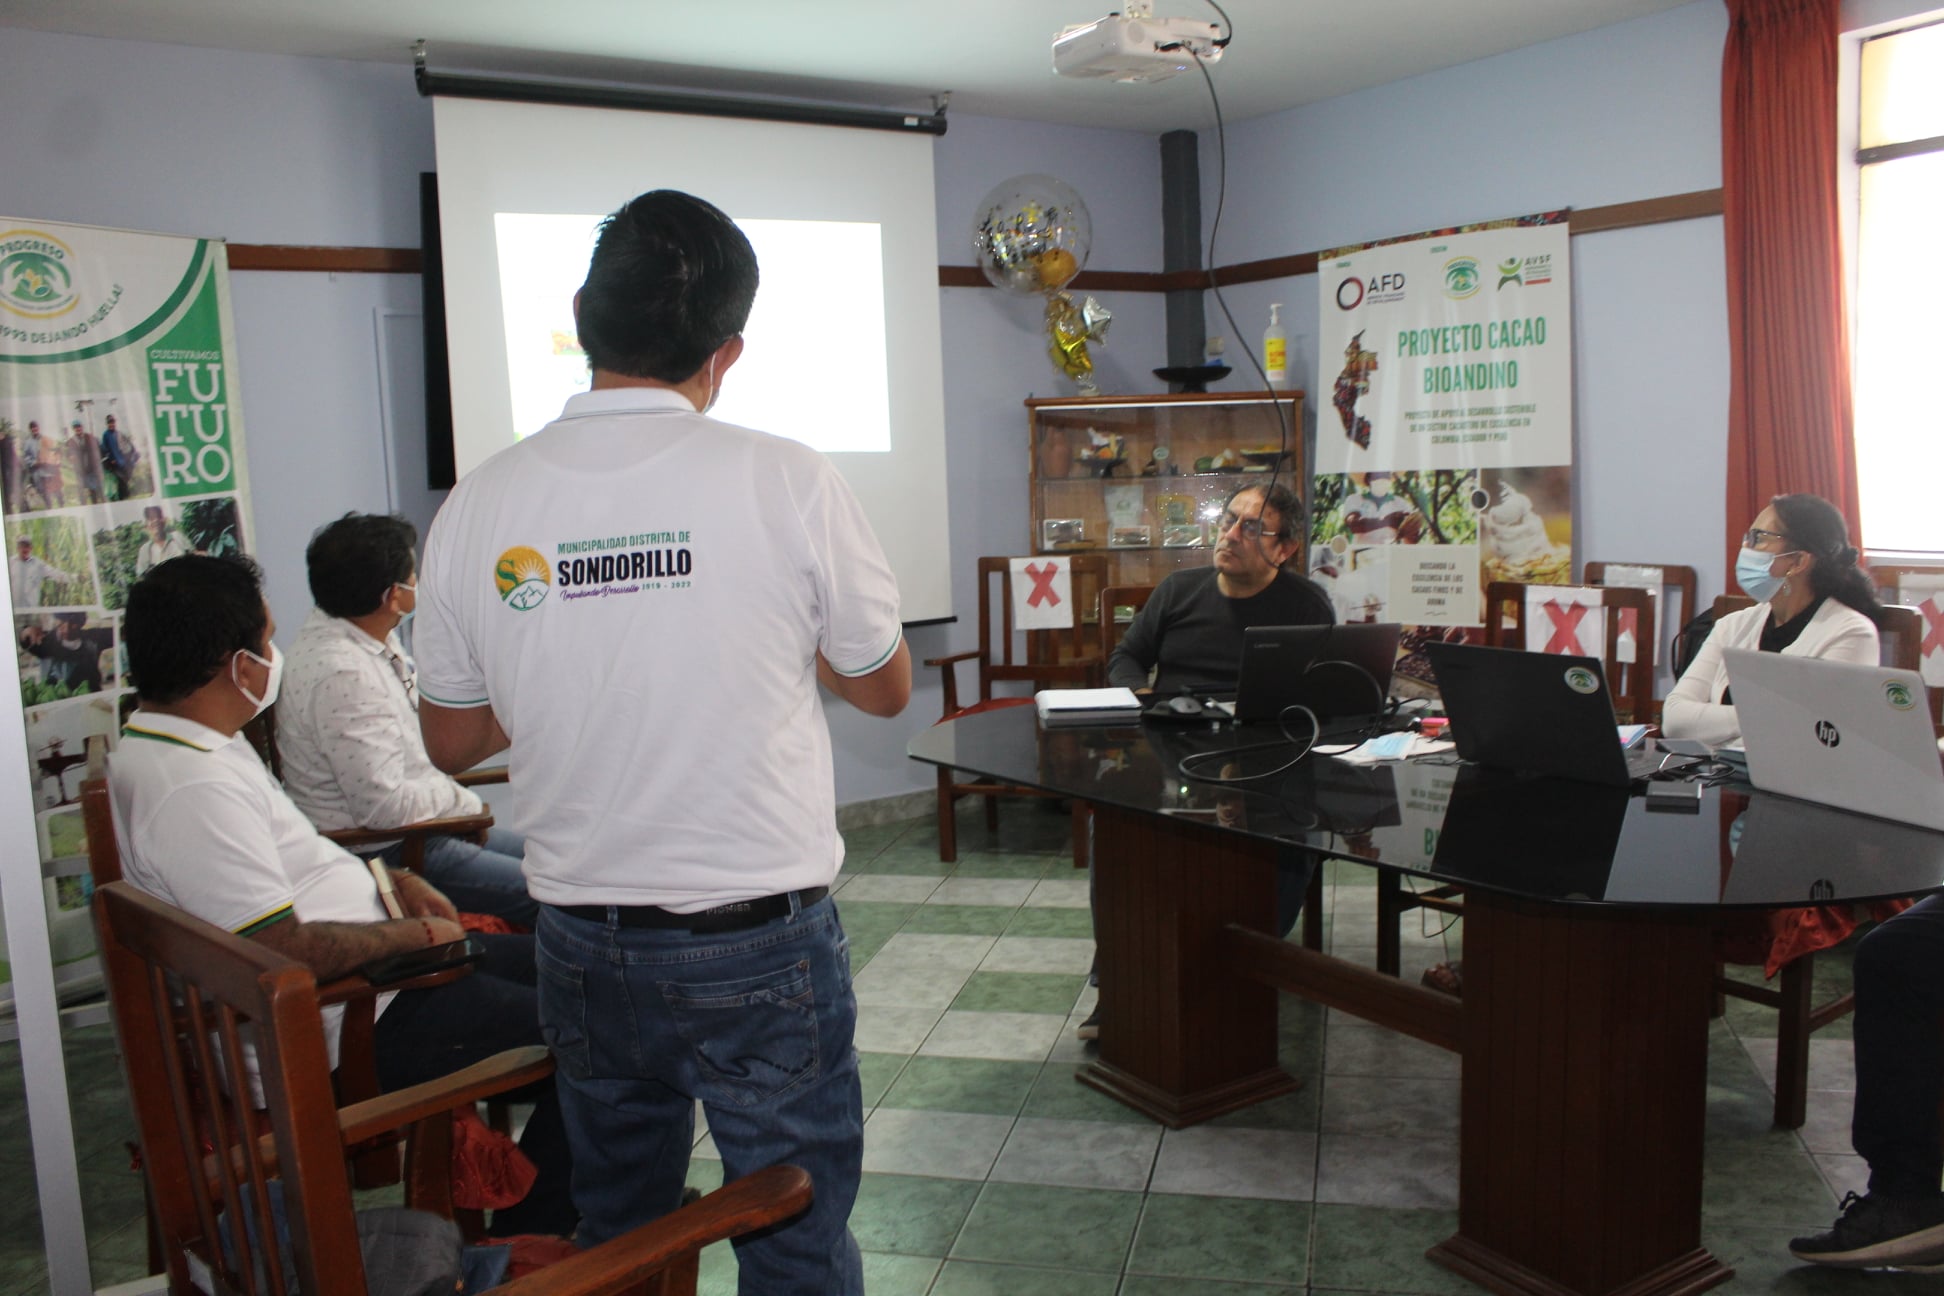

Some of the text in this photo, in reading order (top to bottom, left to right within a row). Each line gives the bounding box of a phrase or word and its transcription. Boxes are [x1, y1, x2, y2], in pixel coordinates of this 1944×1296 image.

[1525, 254, 1551, 265] AVSF
[1367, 273, 1406, 293] AFD
[30, 322, 88, 344] DEJANDO
[1398, 316, 1546, 357] PROYECTO CACAO
[150, 350, 220, 361] CULTIVAMOS
[1423, 360, 1519, 394] BIOANDINO
[557, 531, 691, 555] MUNICIPALIDAD DISTRITAL DE
[557, 548, 692, 587] SONDORILLO
